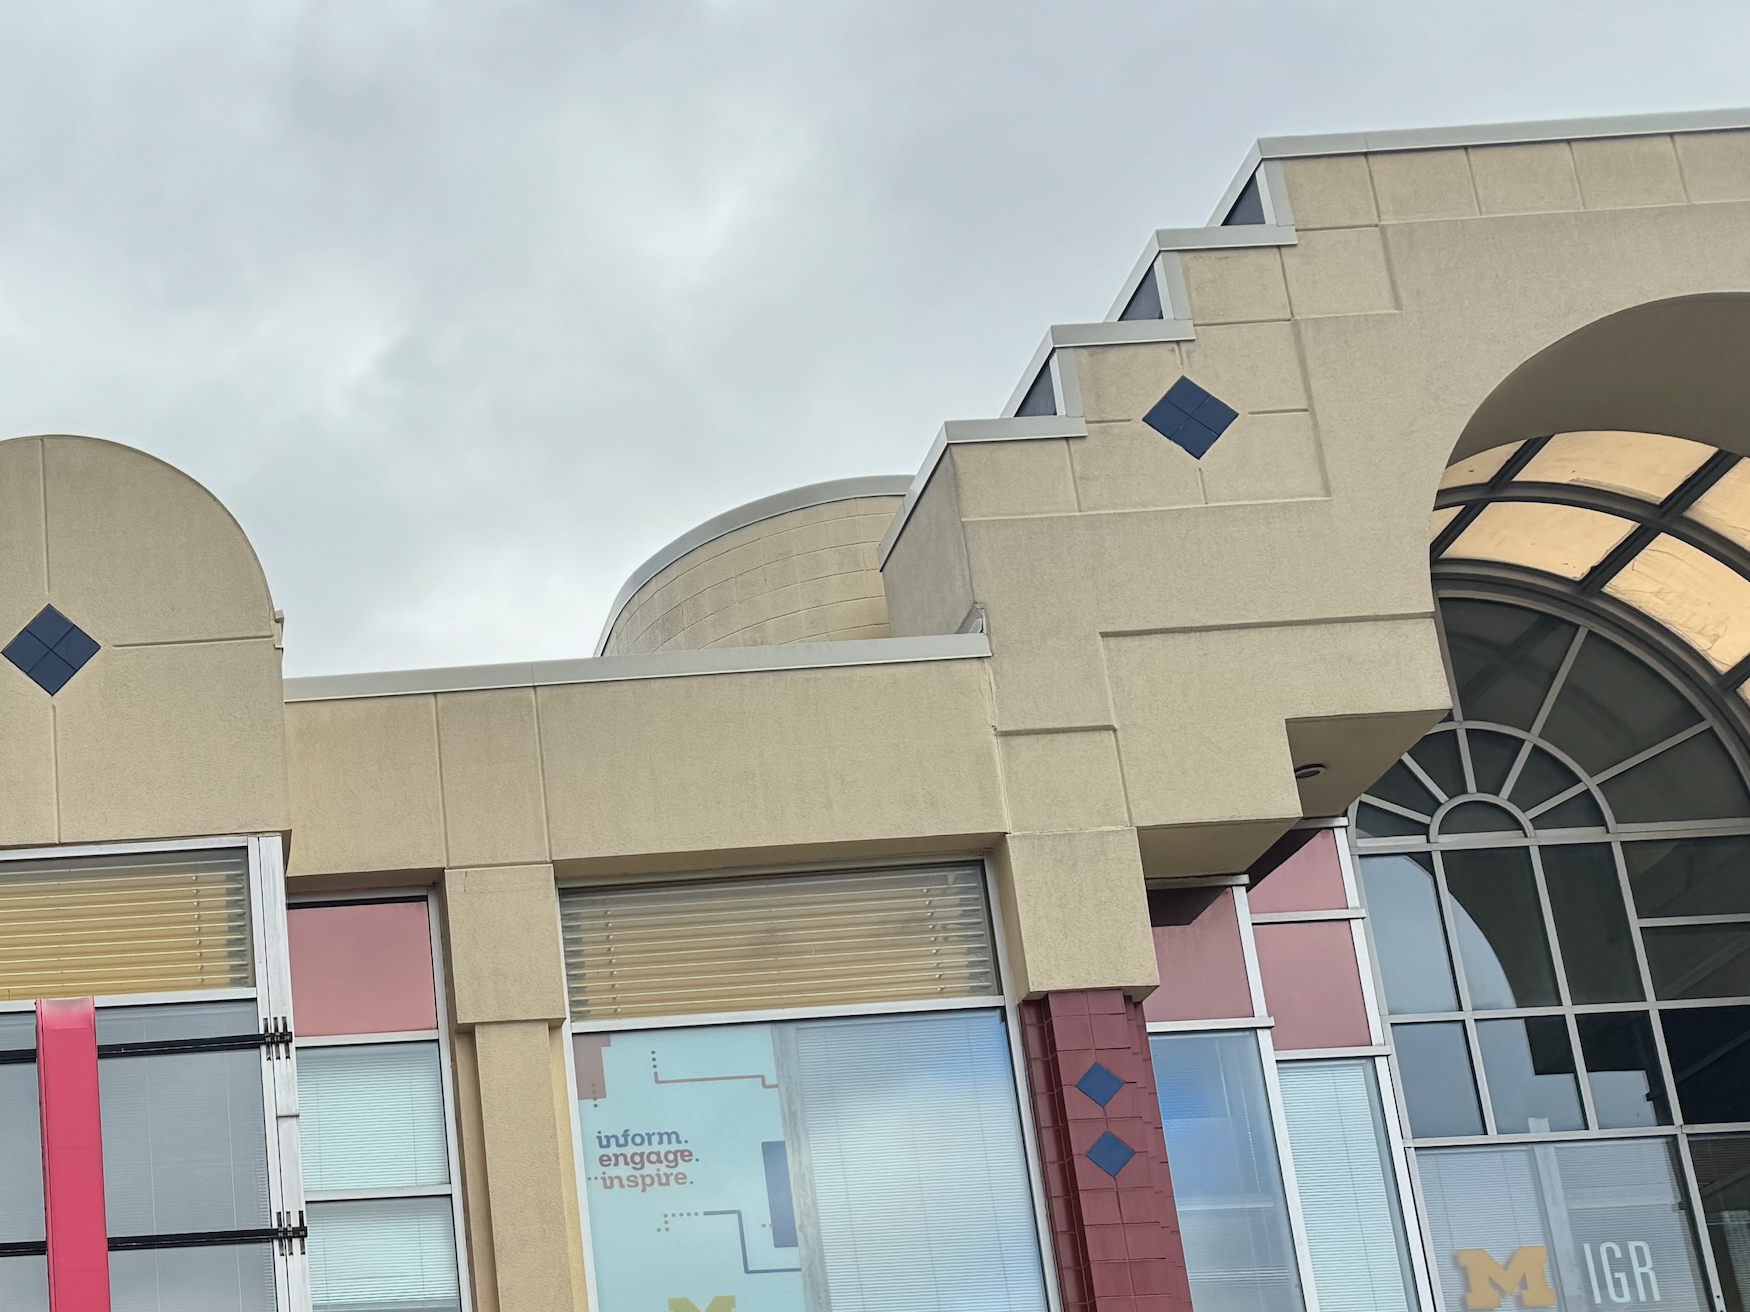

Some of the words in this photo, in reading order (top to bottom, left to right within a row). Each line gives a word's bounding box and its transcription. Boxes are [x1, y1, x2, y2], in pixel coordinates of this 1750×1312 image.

[596, 1129, 688, 1149] inform.
[599, 1149, 699, 1171] engage.
[600, 1168, 694, 1193] inspire.
[1456, 1245, 1557, 1312] M
[1583, 1241, 1661, 1304] IGR
